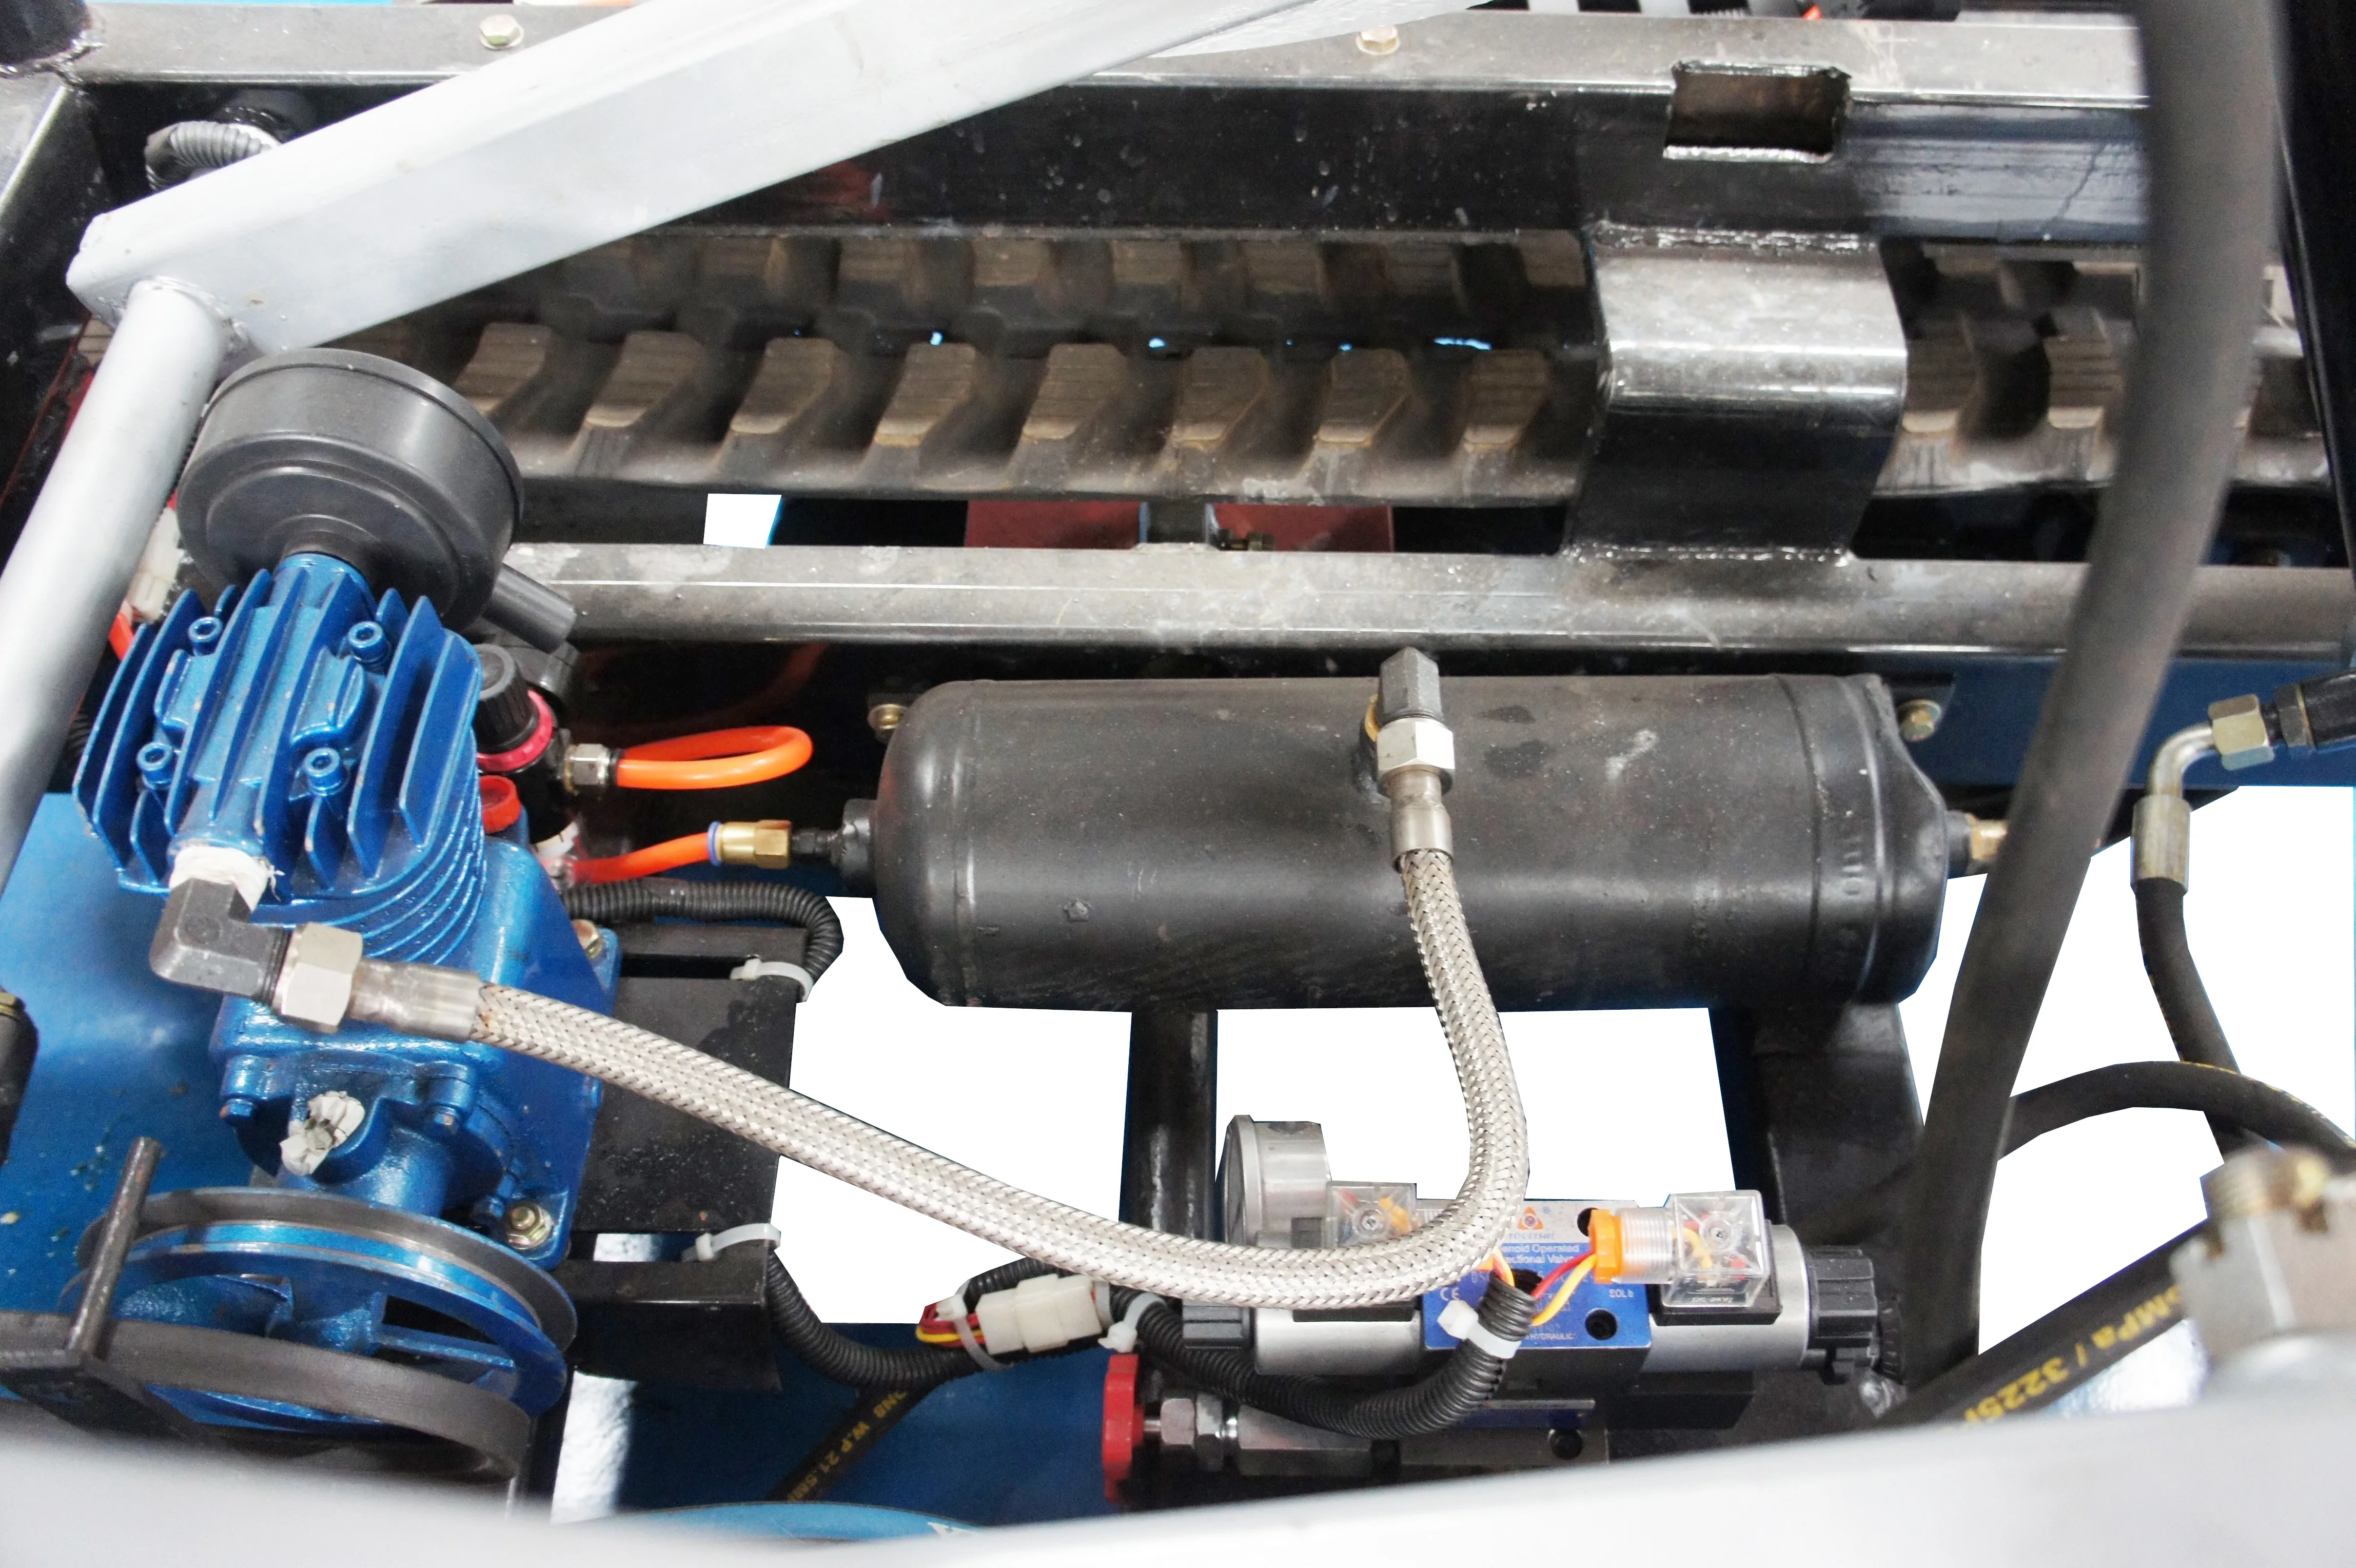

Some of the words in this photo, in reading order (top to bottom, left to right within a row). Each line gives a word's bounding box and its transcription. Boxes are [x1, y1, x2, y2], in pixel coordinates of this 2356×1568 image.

[1502, 1244, 1529, 1253] enoid
[1532, 1244, 1579, 1255] Operated
[1505, 1255, 1545, 1263] ectional
[1440, 1287, 1460, 1302] CE
[1609, 1289, 1627, 1298] SOL
